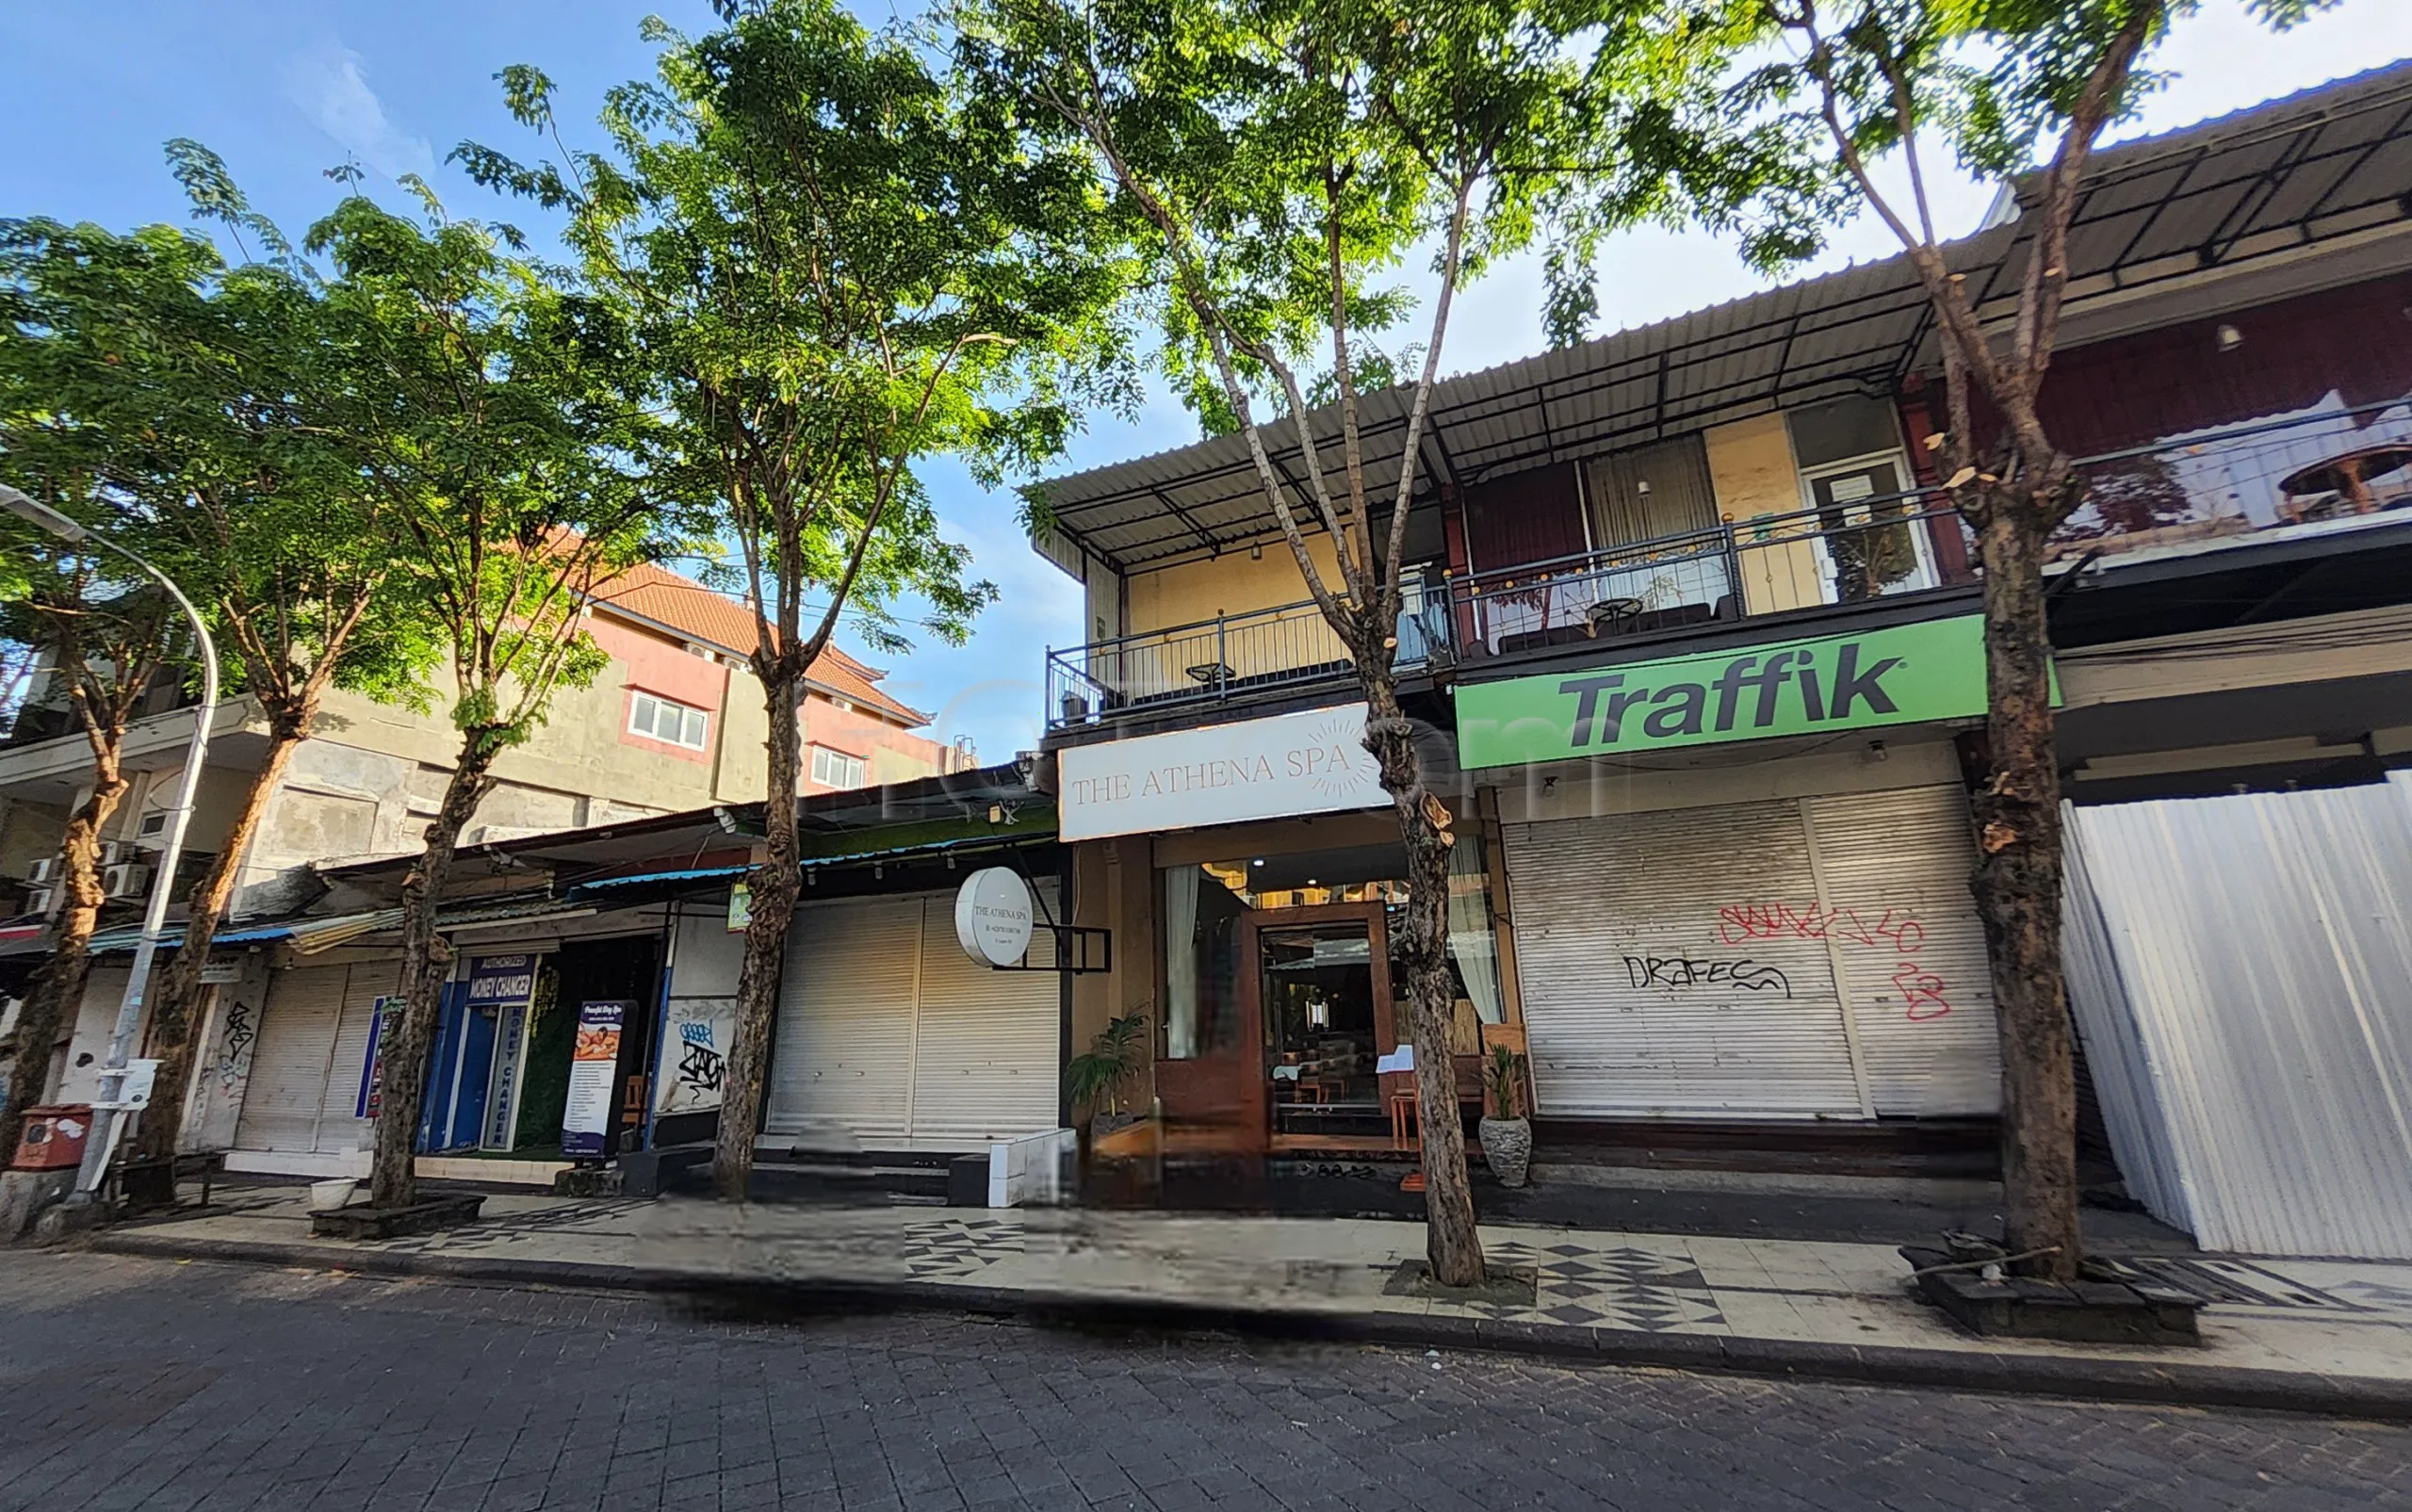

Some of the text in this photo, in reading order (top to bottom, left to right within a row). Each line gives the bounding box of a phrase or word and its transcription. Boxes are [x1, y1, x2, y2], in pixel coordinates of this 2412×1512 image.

[1558, 643, 1903, 748] Traffik
[1071, 743, 1351, 805] THE ATHENA SPA
[974, 905, 1027, 921] THE ATHENA SPA
[481, 955, 527, 968] AUTHORIZED
[469, 974, 530, 1000] MONEY CHANGER
[493, 1007, 521, 1145] MONEY CHANGER
